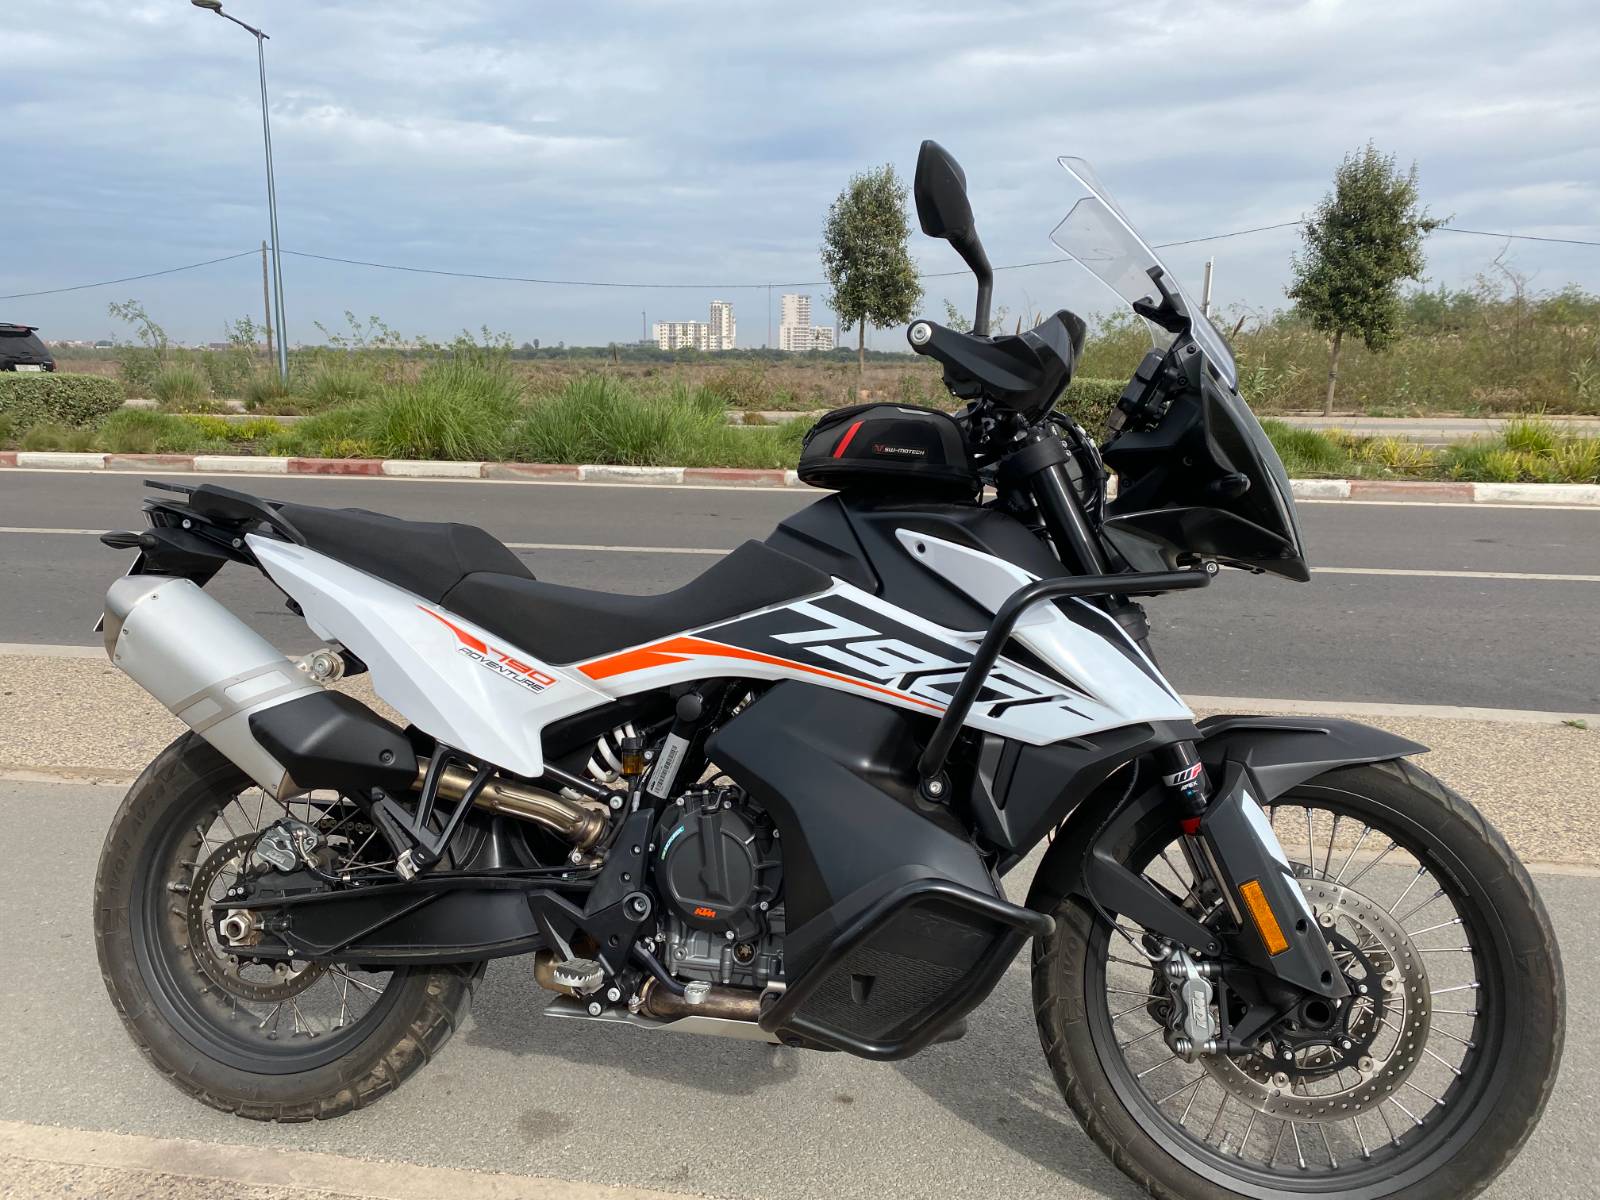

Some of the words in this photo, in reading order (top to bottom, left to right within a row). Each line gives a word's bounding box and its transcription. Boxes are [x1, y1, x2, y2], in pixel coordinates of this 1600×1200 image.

[458, 647, 545, 692] ADVENTURE
[489, 647, 558, 686] 790
[693, 906, 716, 918] KTM
